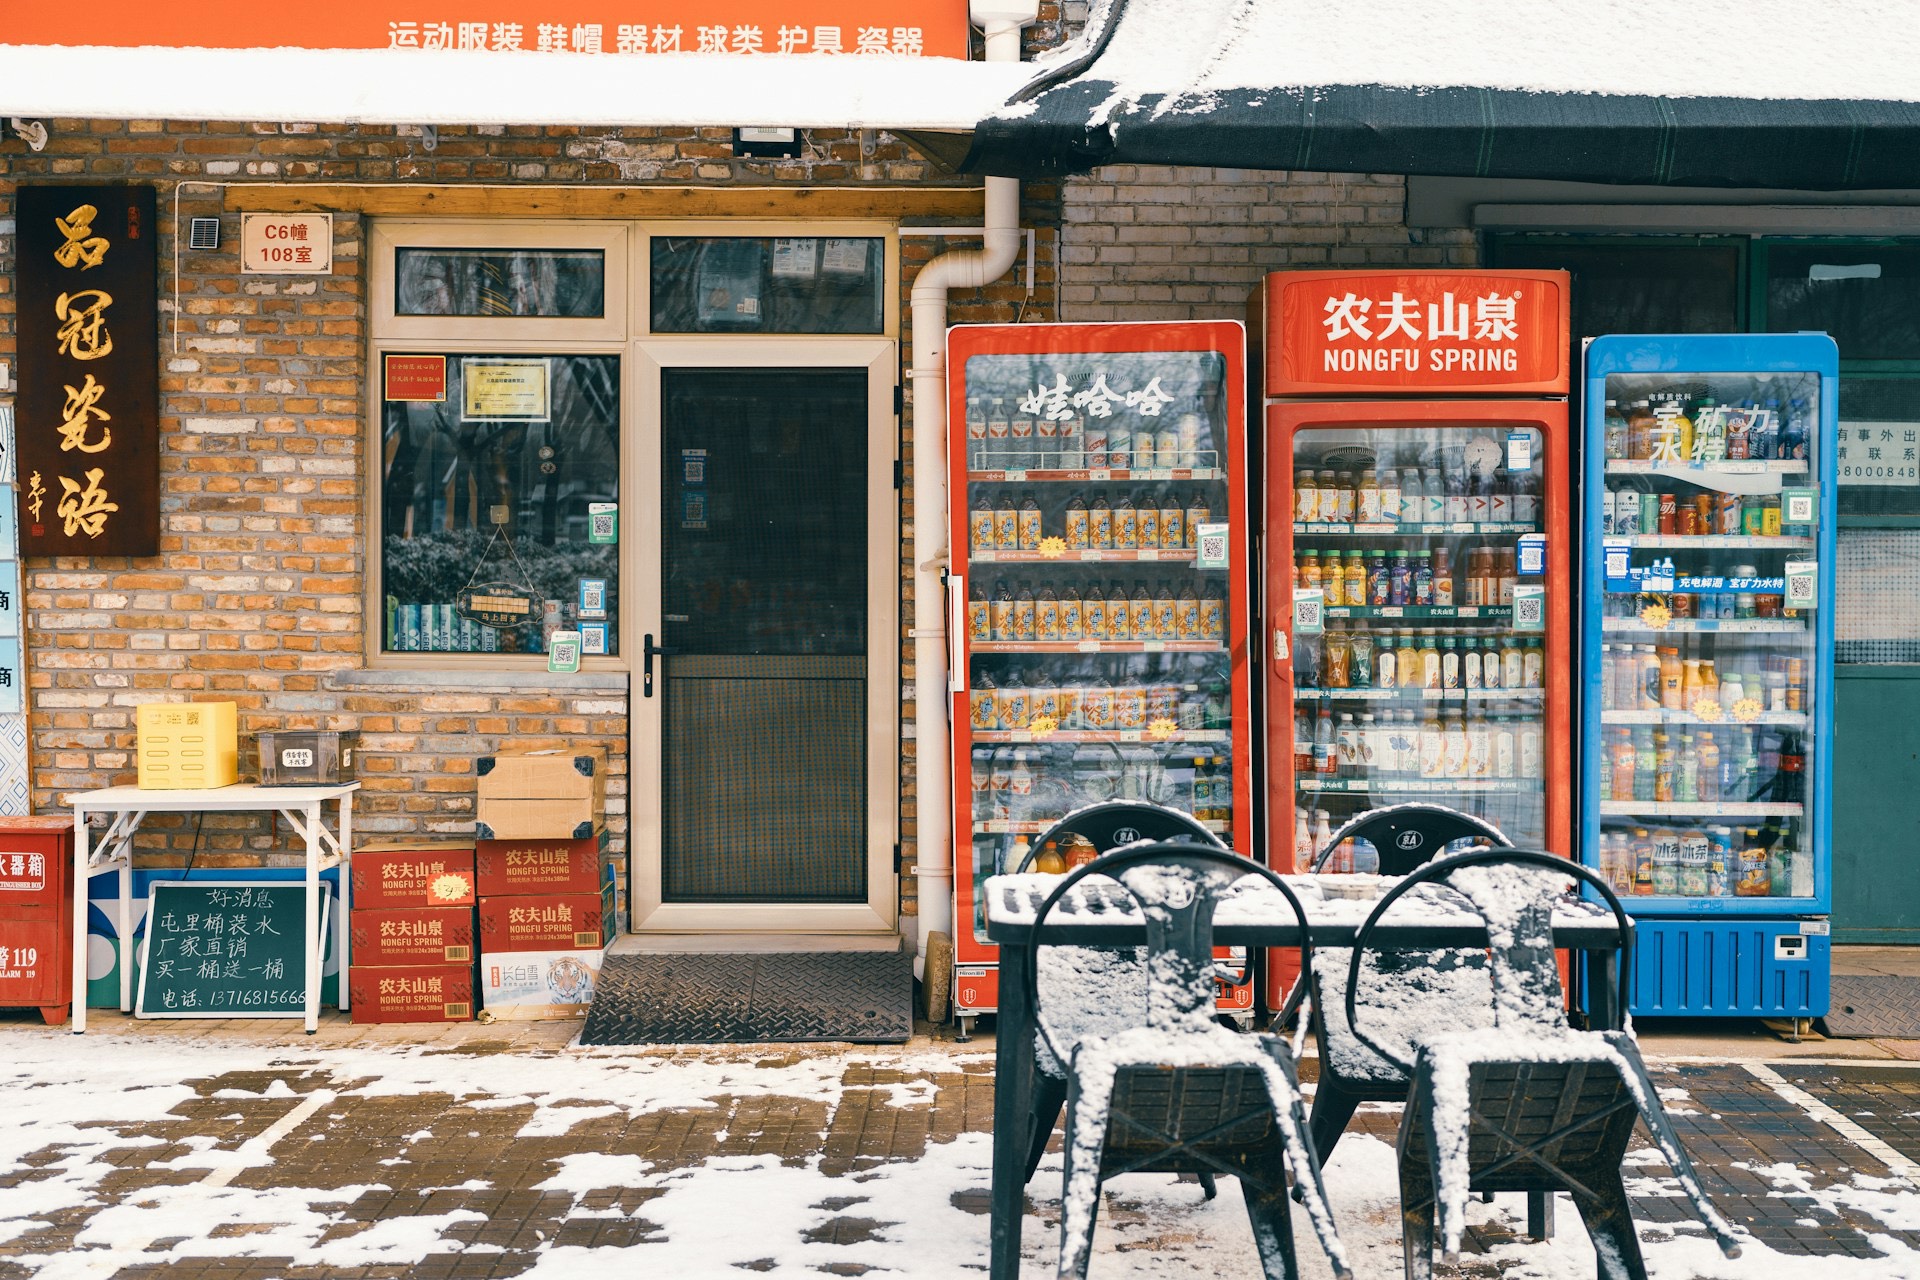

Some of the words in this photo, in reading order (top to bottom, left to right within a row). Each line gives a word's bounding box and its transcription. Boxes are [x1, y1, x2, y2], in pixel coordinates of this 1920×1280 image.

[388, 21, 523, 51] 运动服装
[537, 23, 603, 54] 鞋帽
[617, 24, 683, 54] 器材
[697, 24, 763, 54] 球类
[777, 25, 843, 55] 护具
[265, 224, 309, 242] C6幢
[261, 246, 313, 264] 108室
[1323, 292, 1519, 341] 农夫山泉
[1324, 349, 1420, 371] NONGFU
[1430, 348, 1518, 371] SPRING
[1020, 373, 1174, 420] 娃哈哈
[1649, 393, 1692, 401] 电解质饮料
[1649, 404, 1771, 434] 宝矿力
[1648, 436, 1726, 465] 水特
[1679, 577, 1723, 588] 充电解渴
[1729, 577, 1784, 588] 宝矿力水特
[505, 848, 569, 865] 农夫山泉
[1681, 844, 1707, 860] 冰茶
[382, 862, 444, 879] 农夫山泉
[507, 867, 538, 876] NONGFU
[541, 866, 570, 874] SPRING
[383, 880, 414, 889] NONGFU
[206, 888, 274, 908] 好消息
[509, 905, 572, 923] 农夫山泉
[380, 920, 443, 936] 农夫山泉
[510, 925, 541, 933] NONGFU
[544, 924, 573, 932] SPRING
[156, 935, 248, 958] 厂家直销
[381, 938, 412, 947] NONGFU
[415, 937, 443, 946] SPRING
[14, 947, 37, 967] 119
[26, 969, 36, 978] 119
[155, 958, 284, 980] 买一桶送一桶
[502, 965, 539, 981] 长白雪
[379, 977, 442, 994] 农夫山泉
[380, 995, 411, 1004] NONGFU
[414, 995, 443, 1003] SPRING
